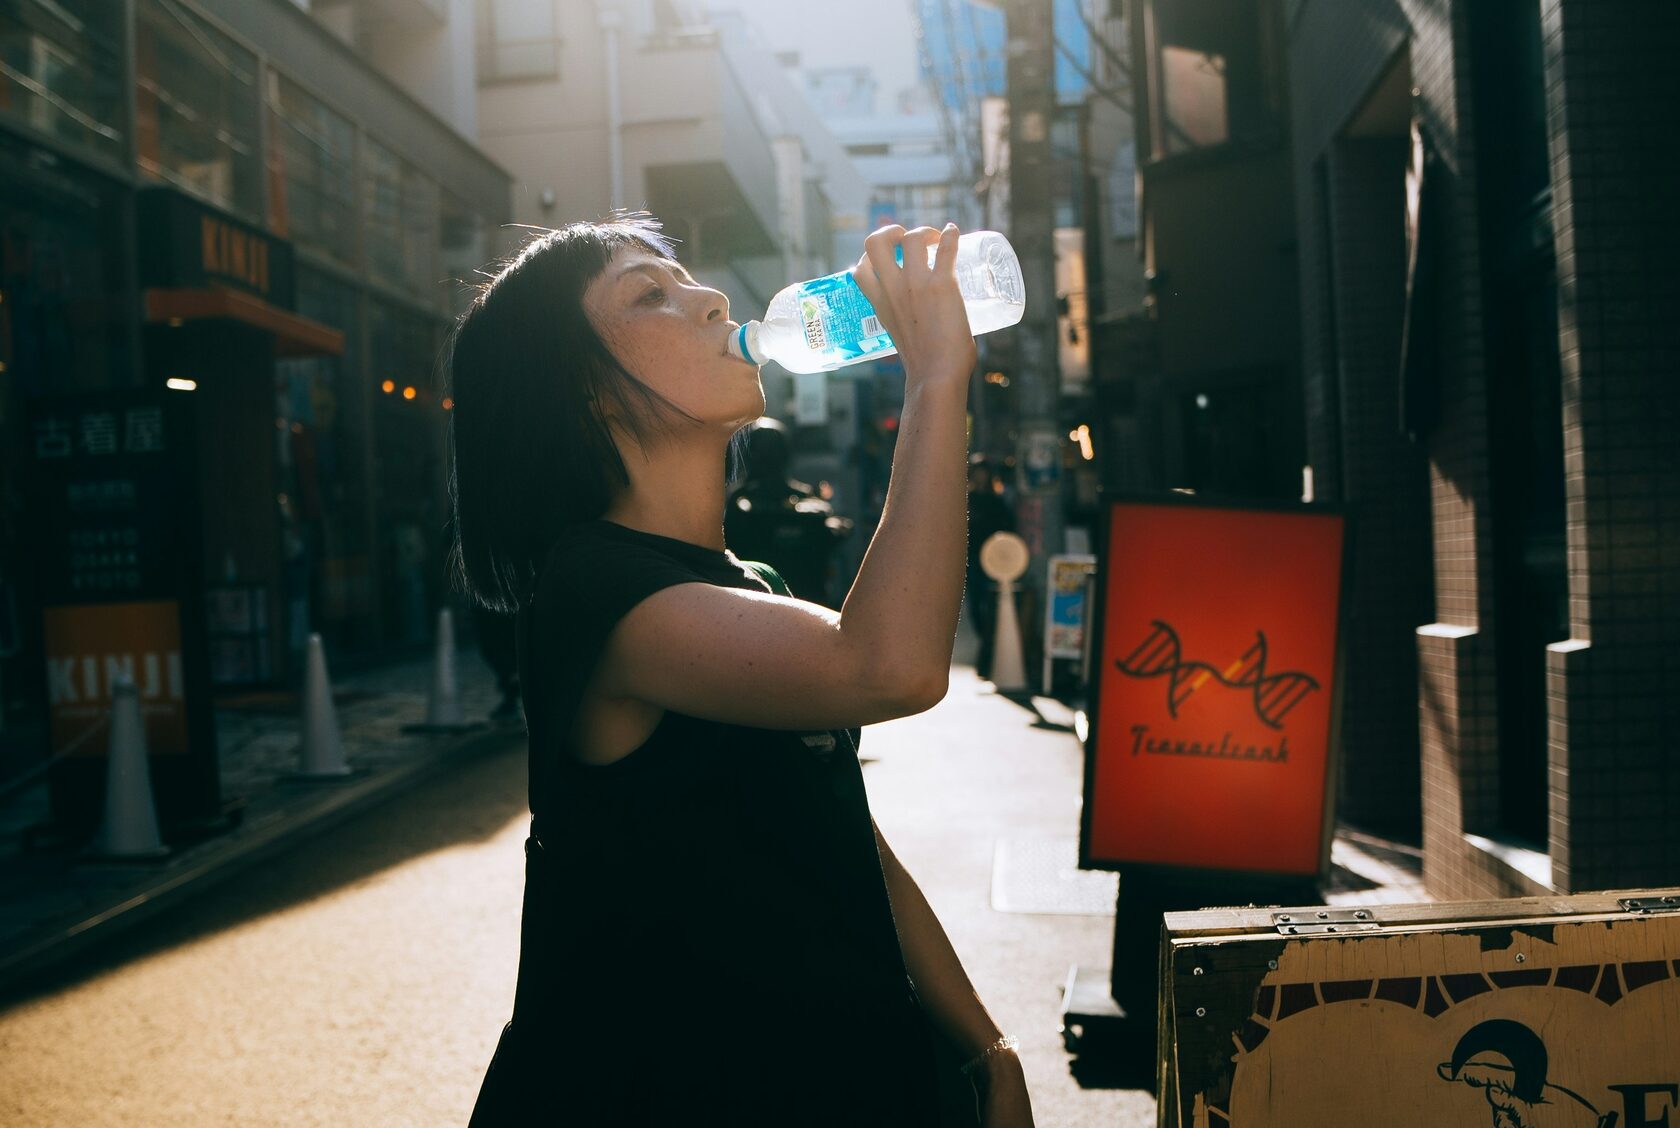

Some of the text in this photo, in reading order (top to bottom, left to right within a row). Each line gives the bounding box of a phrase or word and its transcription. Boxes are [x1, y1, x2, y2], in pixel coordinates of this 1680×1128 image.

[806, 320, 819, 349] GREEN
[34, 407, 164, 458] 古着屋
[46, 651, 185, 704] KINJI
